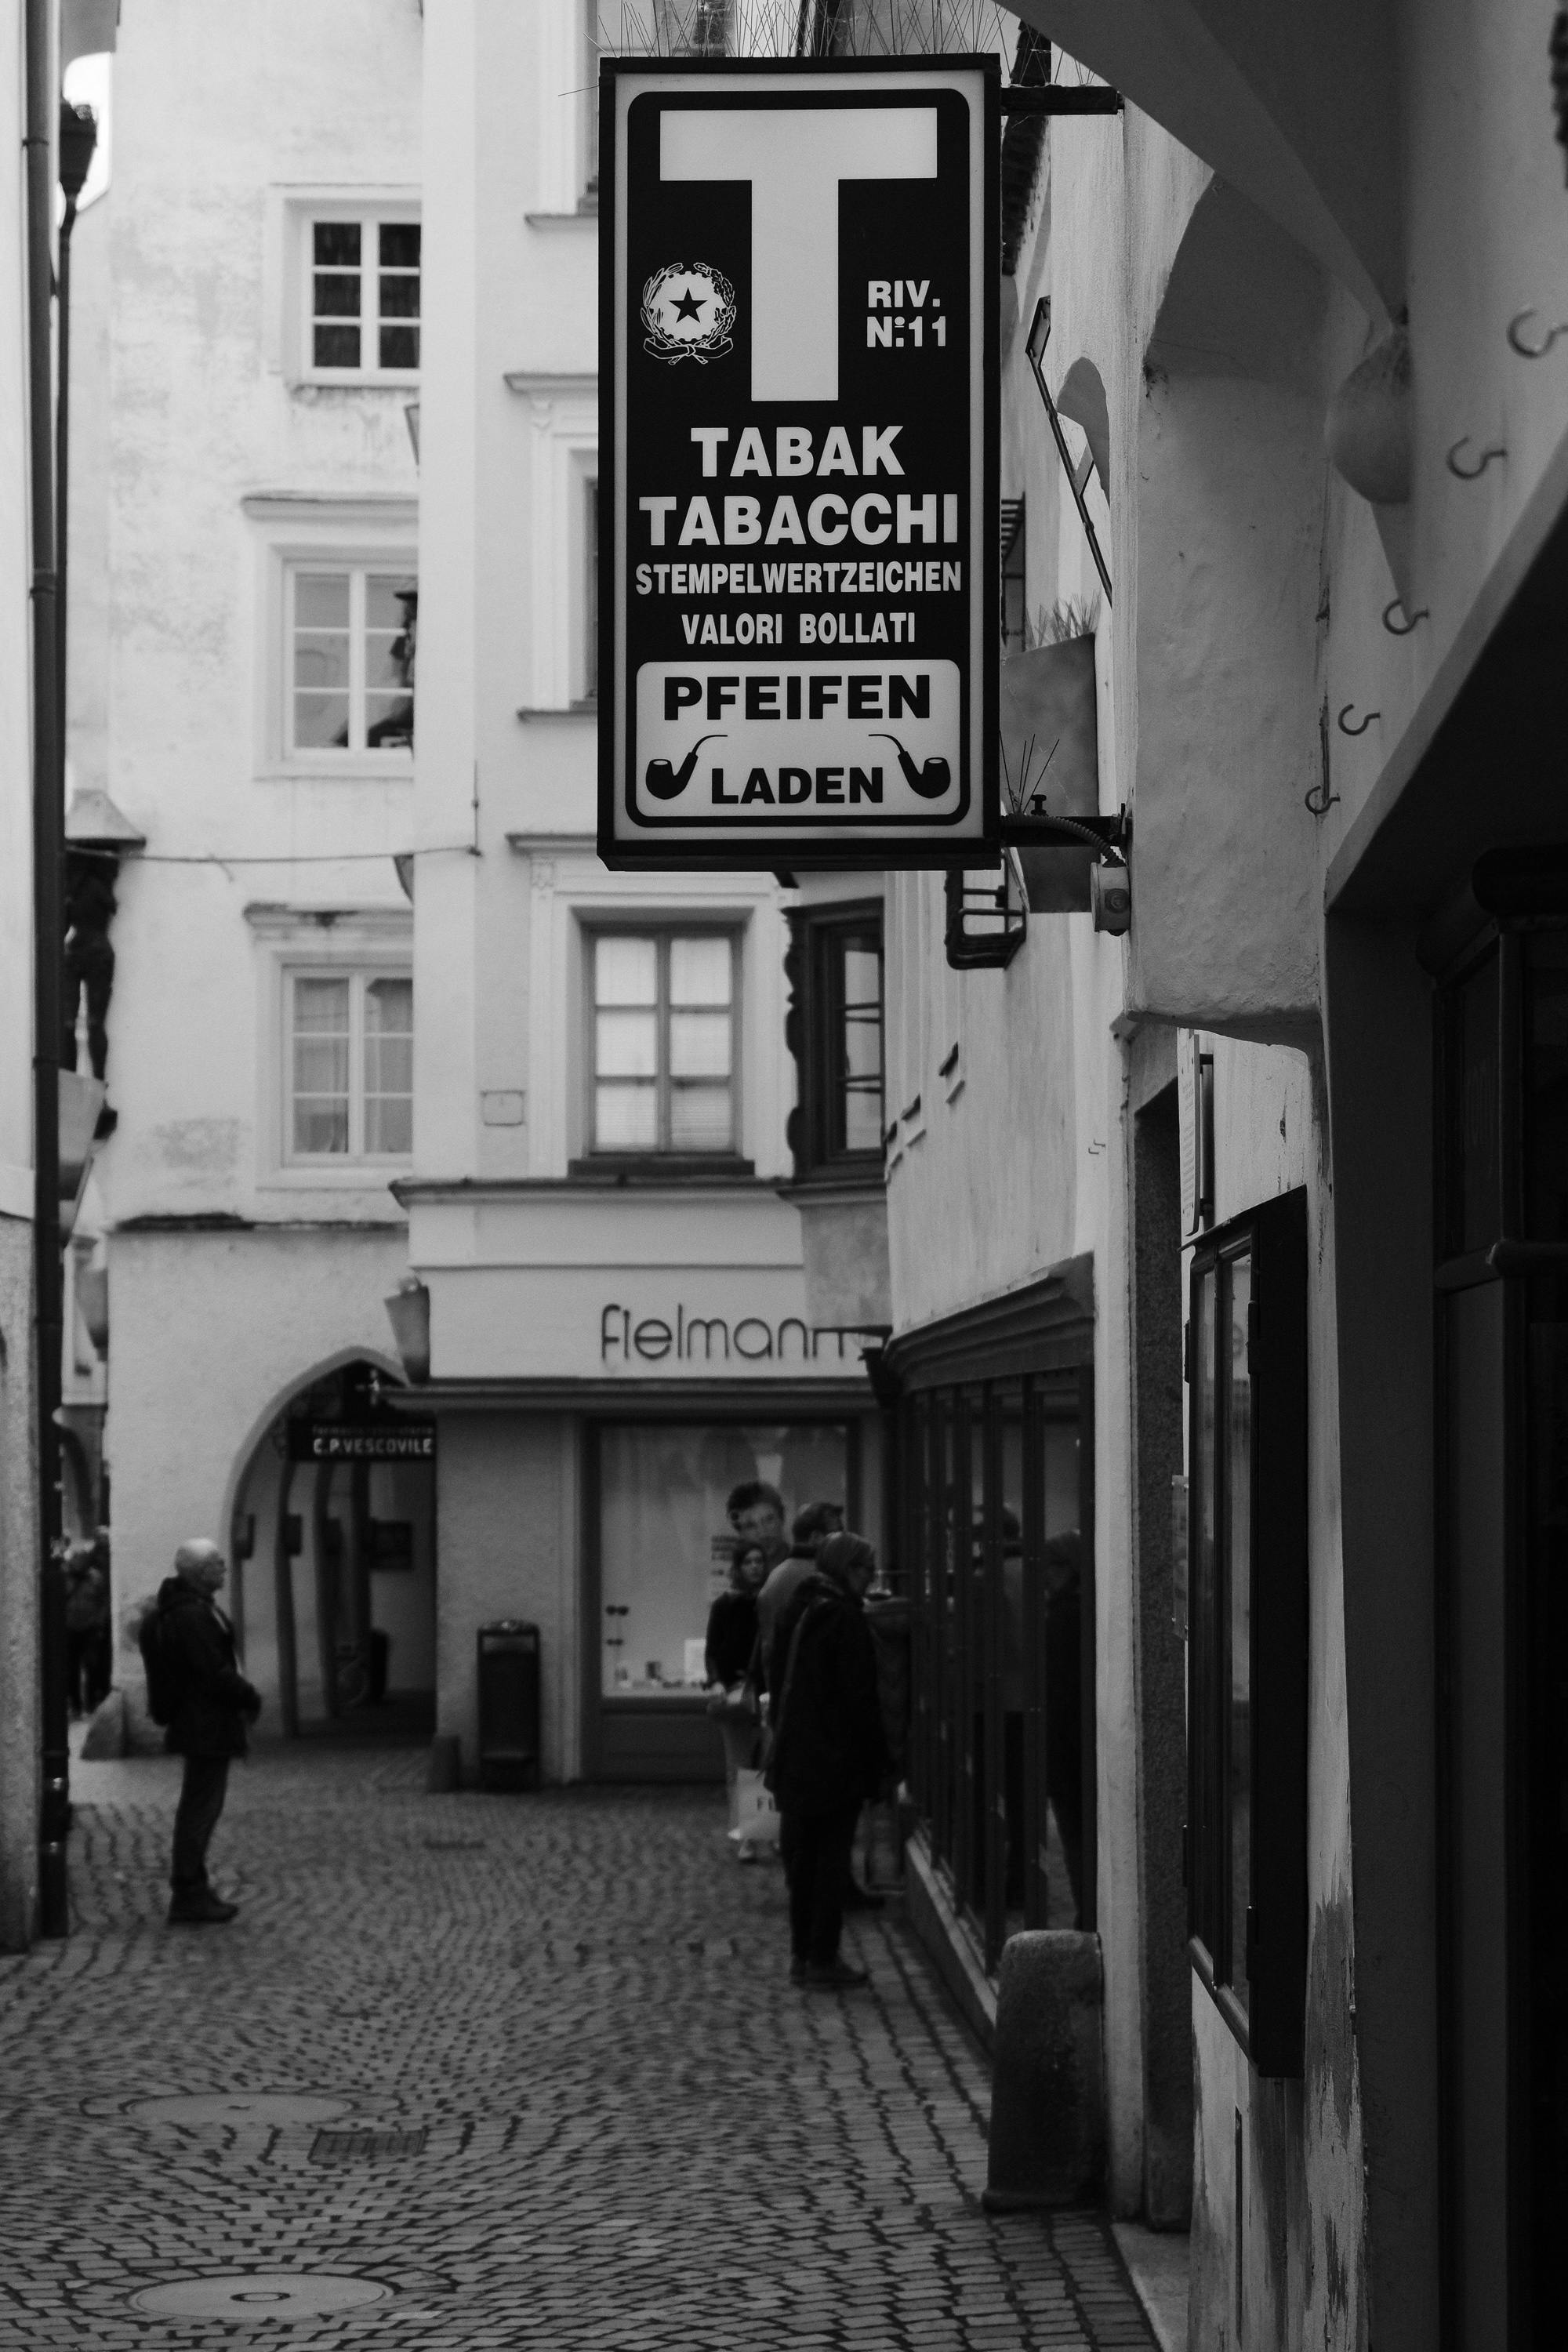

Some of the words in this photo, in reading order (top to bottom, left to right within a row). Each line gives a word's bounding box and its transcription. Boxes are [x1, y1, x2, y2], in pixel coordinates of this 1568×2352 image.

[660, 107, 938, 401] T
[868, 280, 941, 308] RIV.
[690, 426, 906, 477] TABAK
[638, 493, 958, 546] TABACCHI
[635, 561, 961, 595] STEMPELWERTZEICHEN
[681, 612, 782, 645] VALORI
[799, 612, 916, 644] BOLLATI
[664, 674, 930, 720] PFEIFEN
[711, 767, 884, 804] LADEN
